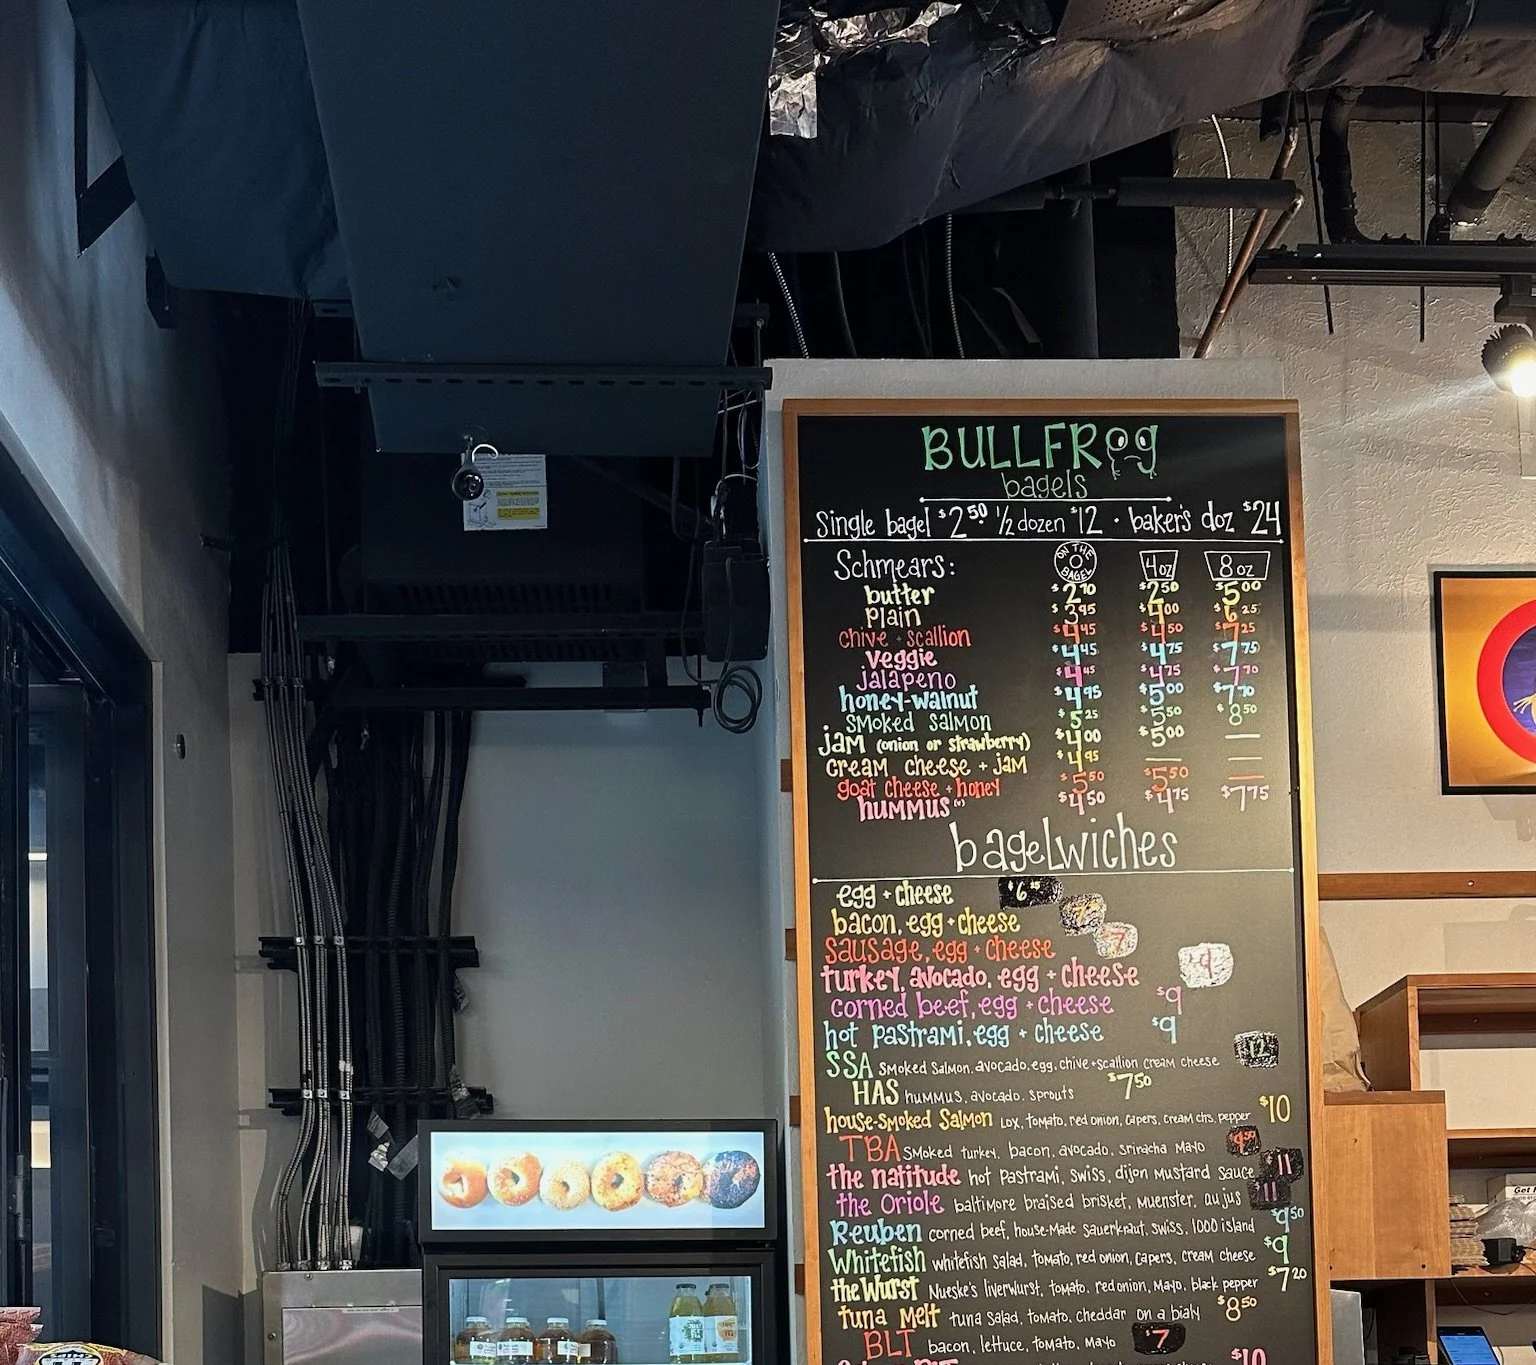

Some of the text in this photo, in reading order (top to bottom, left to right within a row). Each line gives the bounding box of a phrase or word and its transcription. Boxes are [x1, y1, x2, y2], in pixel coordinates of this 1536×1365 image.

[1002, 470, 1088, 500] bagels
[816, 508, 875, 539] Single
[887, 506, 931, 539] bagel
[1017, 507, 1066, 533] dozen
[1071, 506, 1102, 534] $12
[1202, 502, 1235, 532] doz
[1243, 500, 1282, 534] $24
[1057, 544, 1094, 561] ON THE
[1061, 568, 1093, 581] BAGEL
[864, 582, 935, 605] butter
[865, 607, 921, 628] plain
[839, 625, 972, 648] chive scallion
[865, 649, 938, 670] veggie
[856, 666, 956, 691] jalapeno
[839, 685, 978, 713] honey-walnut
[927, 740, 941, 752] or
[826, 758, 889, 777] cream
[837, 778, 1000, 800] goat honey
[837, 881, 954, 909] egg cheese
[906, 912, 943, 937] egg
[958, 907, 1020, 934] cheese
[933, 939, 968, 964] egg
[1062, 956, 1140, 988] cheese
[831, 991, 908, 1019] corned
[979, 995, 1017, 1019] egg
[1038, 987, 1114, 1015] cheese
[1157, 986, 1182, 1015] $9
[823, 1020, 858, 1050] hot
[1152, 1016, 1176, 1044] $9
[826, 1051, 1089, 1079] SSA chive
[852, 1079, 1074, 1105] HAS sprouts
[1070, 1114, 1087, 1126] red
[1218, 1112, 1251, 1124] pepper
[1259, 1095, 1291, 1123] $10
[839, 1135, 900, 1162] TBA
[826, 1163, 1255, 1190] the natitude hot dijon sauce
[837, 1190, 1074, 1217] the Oriole braised
[830, 1217, 1255, 1246] Reuben corned 1000 island
[828, 1235, 1289, 1275] Whitefish whitefish red $9
[831, 1278, 859, 1303] the
[1191, 1275, 1218, 1290] black
[1223, 1278, 1258, 1291] pepper
[838, 1305, 888, 1329] tuna
[949, 1312, 982, 1326] tuna
[1076, 1307, 1127, 1323] cheddar
[1137, 1308, 1152, 1320] on
[1157, 1309, 1165, 1319] a
[1171, 1304, 1200, 1321] bialy
[863, 1329, 915, 1359] BLT
